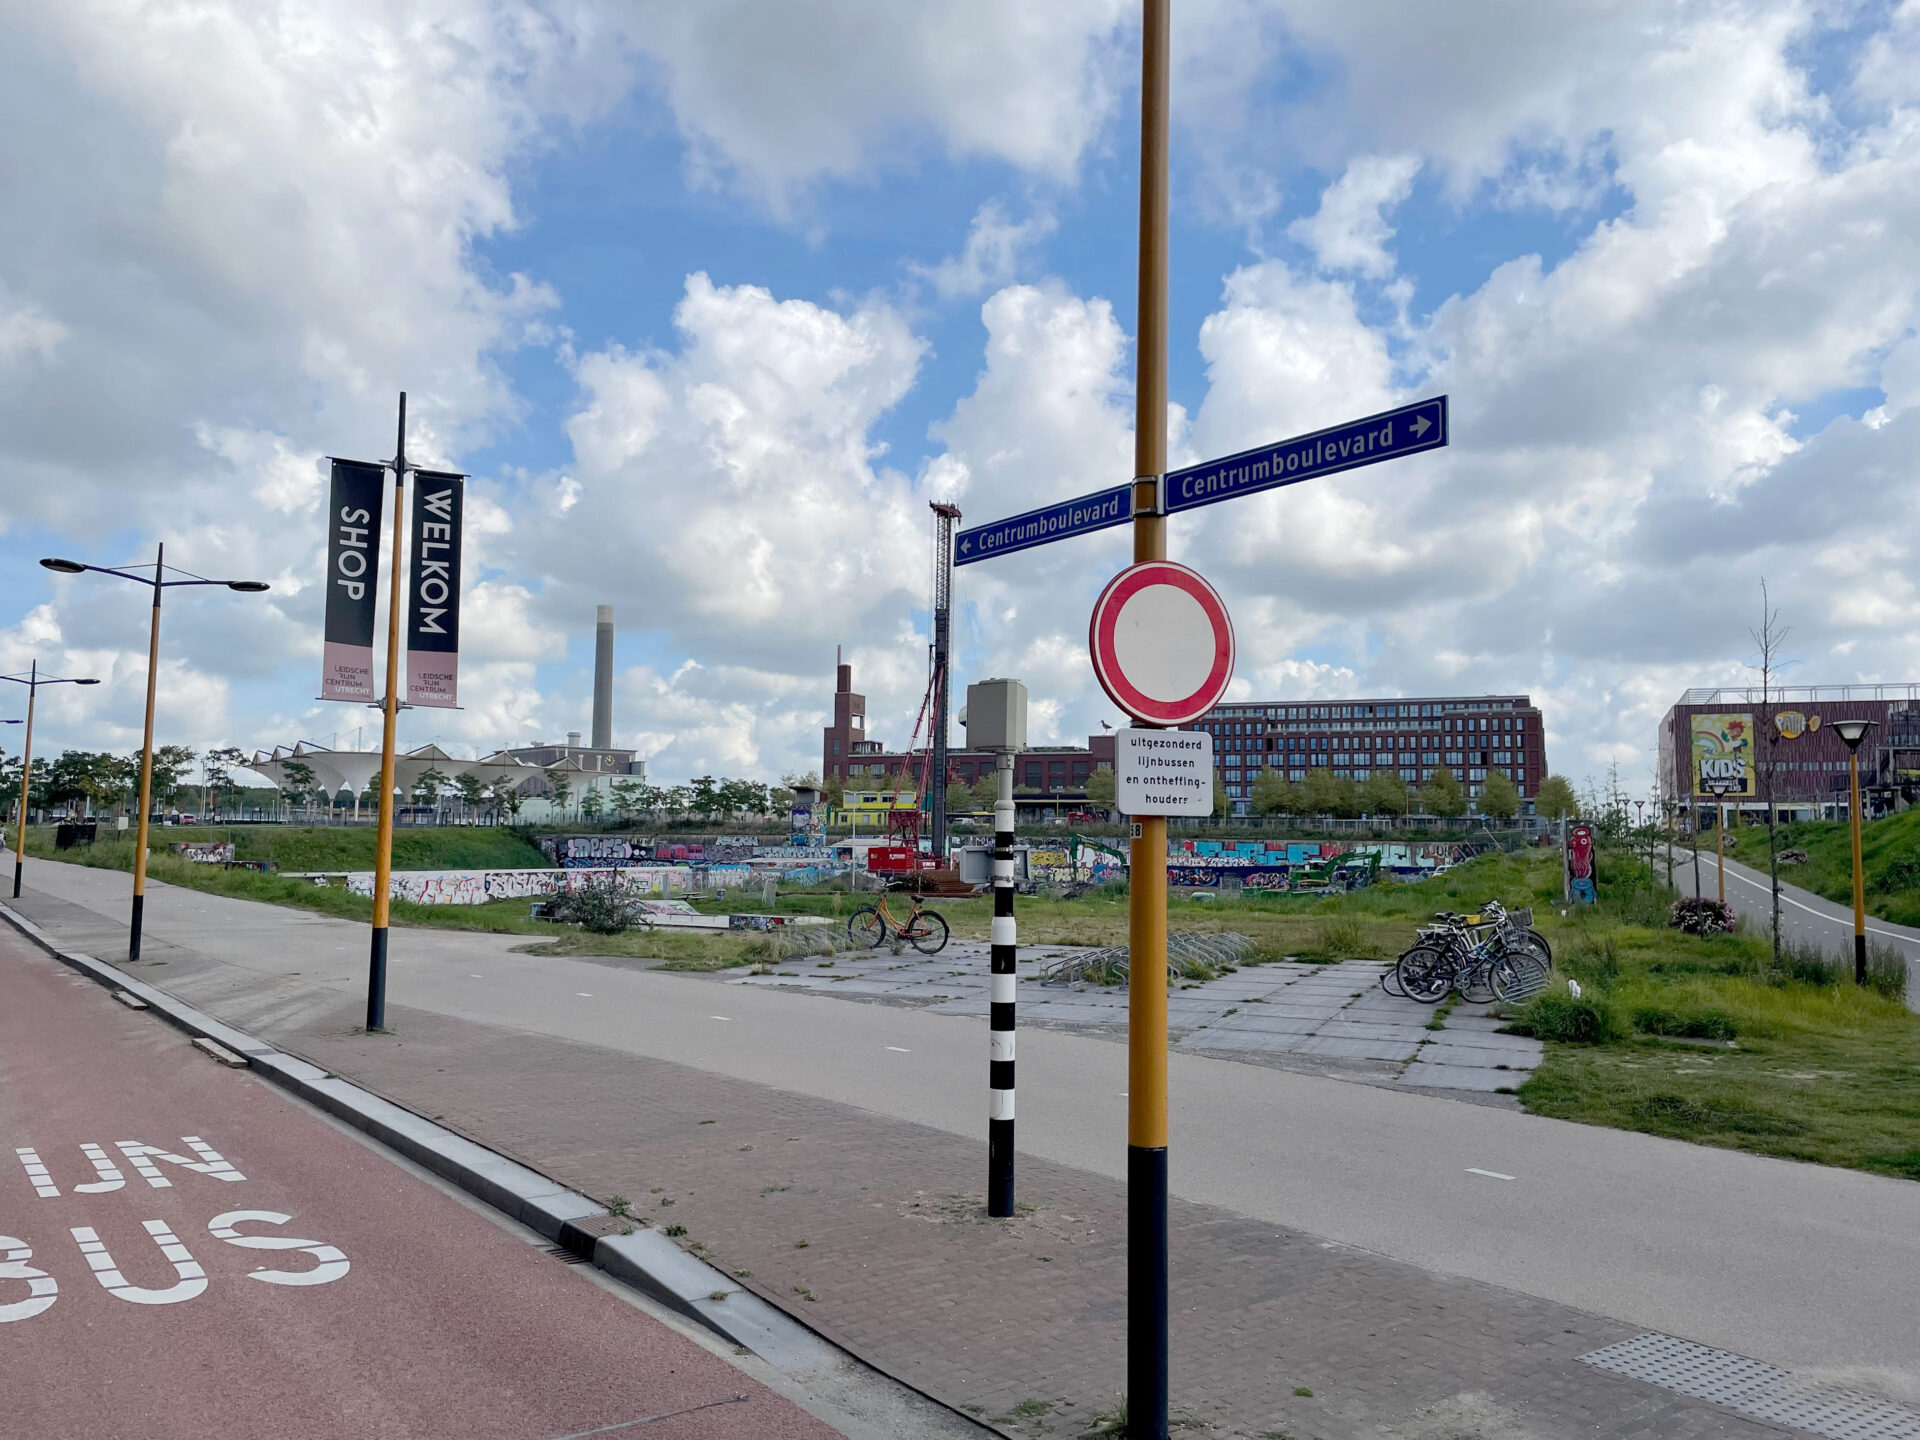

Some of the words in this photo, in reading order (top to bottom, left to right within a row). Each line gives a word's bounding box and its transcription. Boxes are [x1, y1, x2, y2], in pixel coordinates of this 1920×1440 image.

[1182, 421, 1393, 499] Centrumboulevard
[978, 494, 1119, 551] Centrumboulevard
[337, 505, 370, 601] SHOP
[418, 488, 453, 634] WELKOM
[334, 665, 369, 675] LEIDSCHE
[418, 672, 454, 681] LEIDSCHE
[335, 686, 370, 695] UTRECHT
[419, 692, 453, 701] UTRECHT
[1131, 737, 1202, 750] uitgezonderd
[1138, 756, 1195, 768] lijnbussen
[1700, 758, 1746, 779] KIDS
[1126, 775, 1139, 784] en
[1143, 775, 1206, 789] ontheffing-
[1145, 794, 1188, 804] houders
[0, 1210, 351, 1323] BUS
